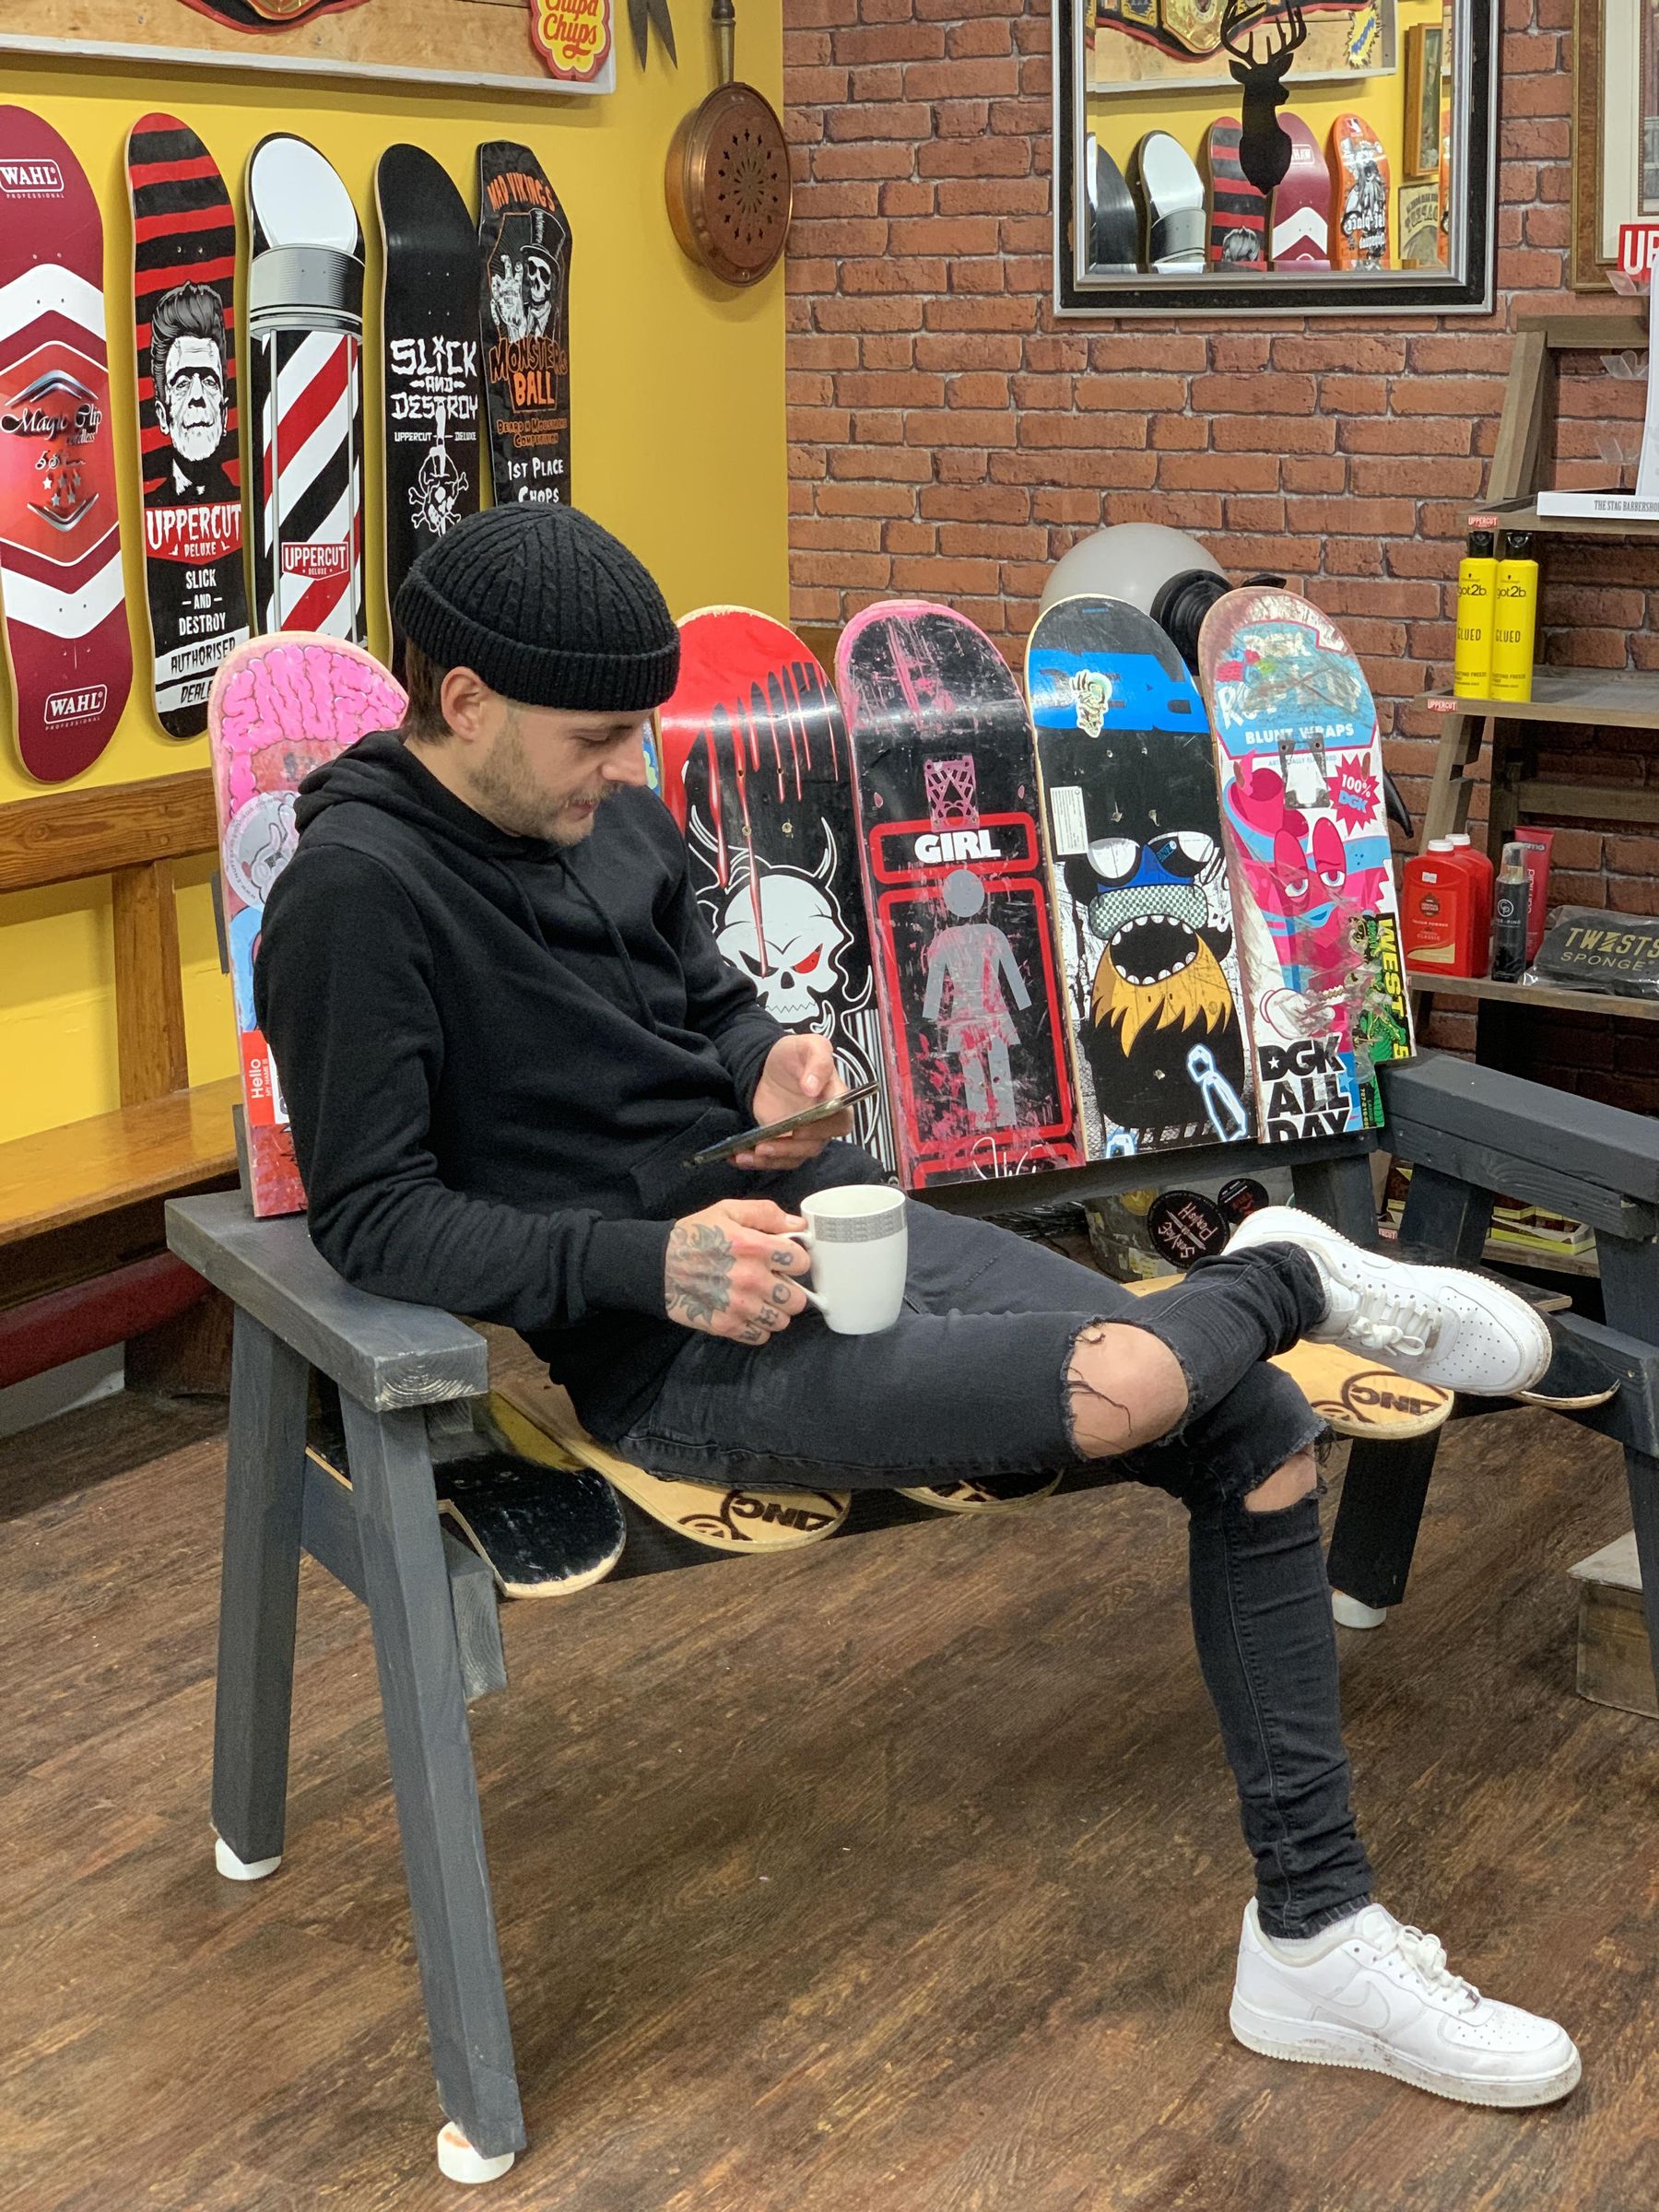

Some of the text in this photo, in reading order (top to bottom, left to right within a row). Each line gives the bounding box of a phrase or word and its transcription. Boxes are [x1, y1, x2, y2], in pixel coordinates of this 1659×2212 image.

[544, 14, 597, 59] Chups
[0, 167, 57, 184] WAHL
[487, 174, 509, 212] MAD
[390, 335, 477, 378] SLICK
[425, 376, 453, 393] AND
[513, 371, 556, 406] BALL
[390, 392, 478, 420] DESTROY
[394, 431, 477, 441] UPPERCUT DELUXE
[507, 457, 564, 480] 1ST PLACE
[518, 486, 559, 503] CHOPS
[1594, 500, 1606, 511] THE
[1607, 501, 1622, 511] STAG
[147, 504, 242, 550] UPPERCUT
[184, 542, 217, 558] DELUXE
[285, 547, 346, 570] UPPERCUT
[185, 569, 217, 589] SLICK
[194, 594, 212, 609] AND
[1458, 584, 1487, 598] got2b
[1497, 585, 1526, 599] got2b
[178, 612, 226, 636] DESTROY
[1457, 628, 1481, 641] GLUED
[1495, 629, 1521, 642] GLUED
[171, 636, 236, 675] AUTHORISED
[181, 679, 213, 704] DEALE
[50, 692, 100, 716] WAHL
[45, 716, 100, 731] PROFESSIONAL
[1245, 724, 1354, 744] BLUNT WRAPS
[1341, 773, 1371, 798] 100%
[1338, 790, 1369, 812] DGK
[914, 830, 1001, 864] GIRL
[1380, 919, 1404, 1018] WEST
[1560, 951, 1646, 971] SPONGE
[1258, 1034, 1345, 1081] DGK
[249, 1058, 265, 1099] Hello
[265, 1086, 272, 1097] MY
[1267, 1074, 1350, 1120] ALL
[1267, 1109, 1349, 1144] DAY
[1349, 1386, 1441, 1417] ZINC
[730, 1498, 836, 1532] ZINC
